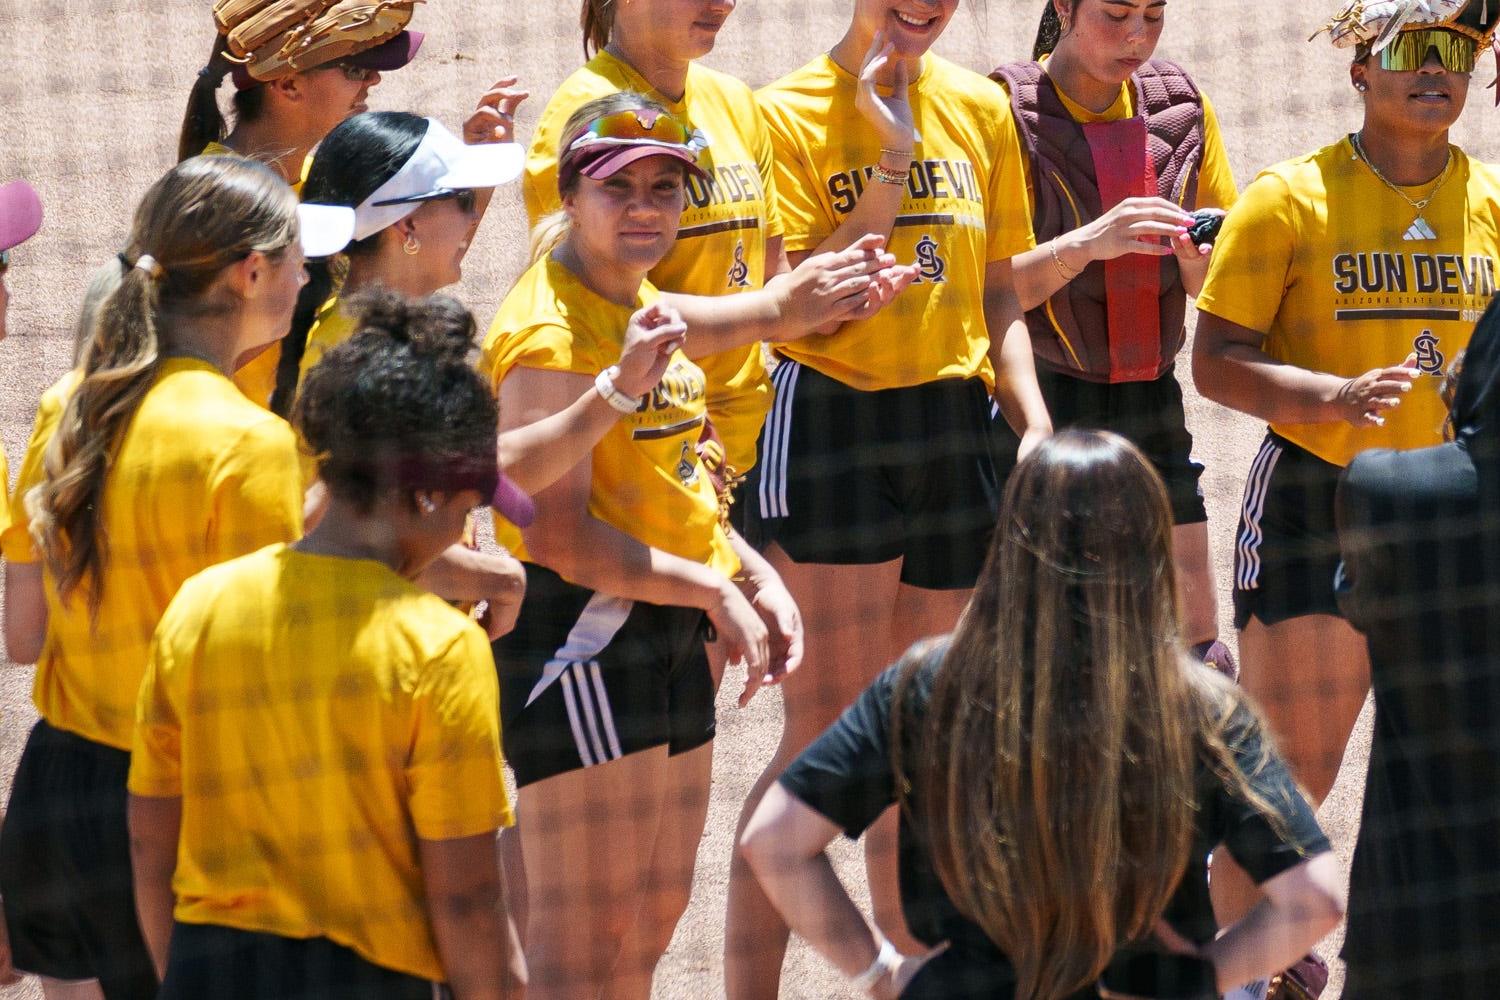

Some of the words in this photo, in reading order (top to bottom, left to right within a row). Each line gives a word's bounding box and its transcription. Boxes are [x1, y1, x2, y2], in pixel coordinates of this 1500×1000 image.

[904, 158, 982, 205] DEVIL
[1332, 251, 1408, 295] SUN
[1411, 252, 1500, 298] DEVIL
